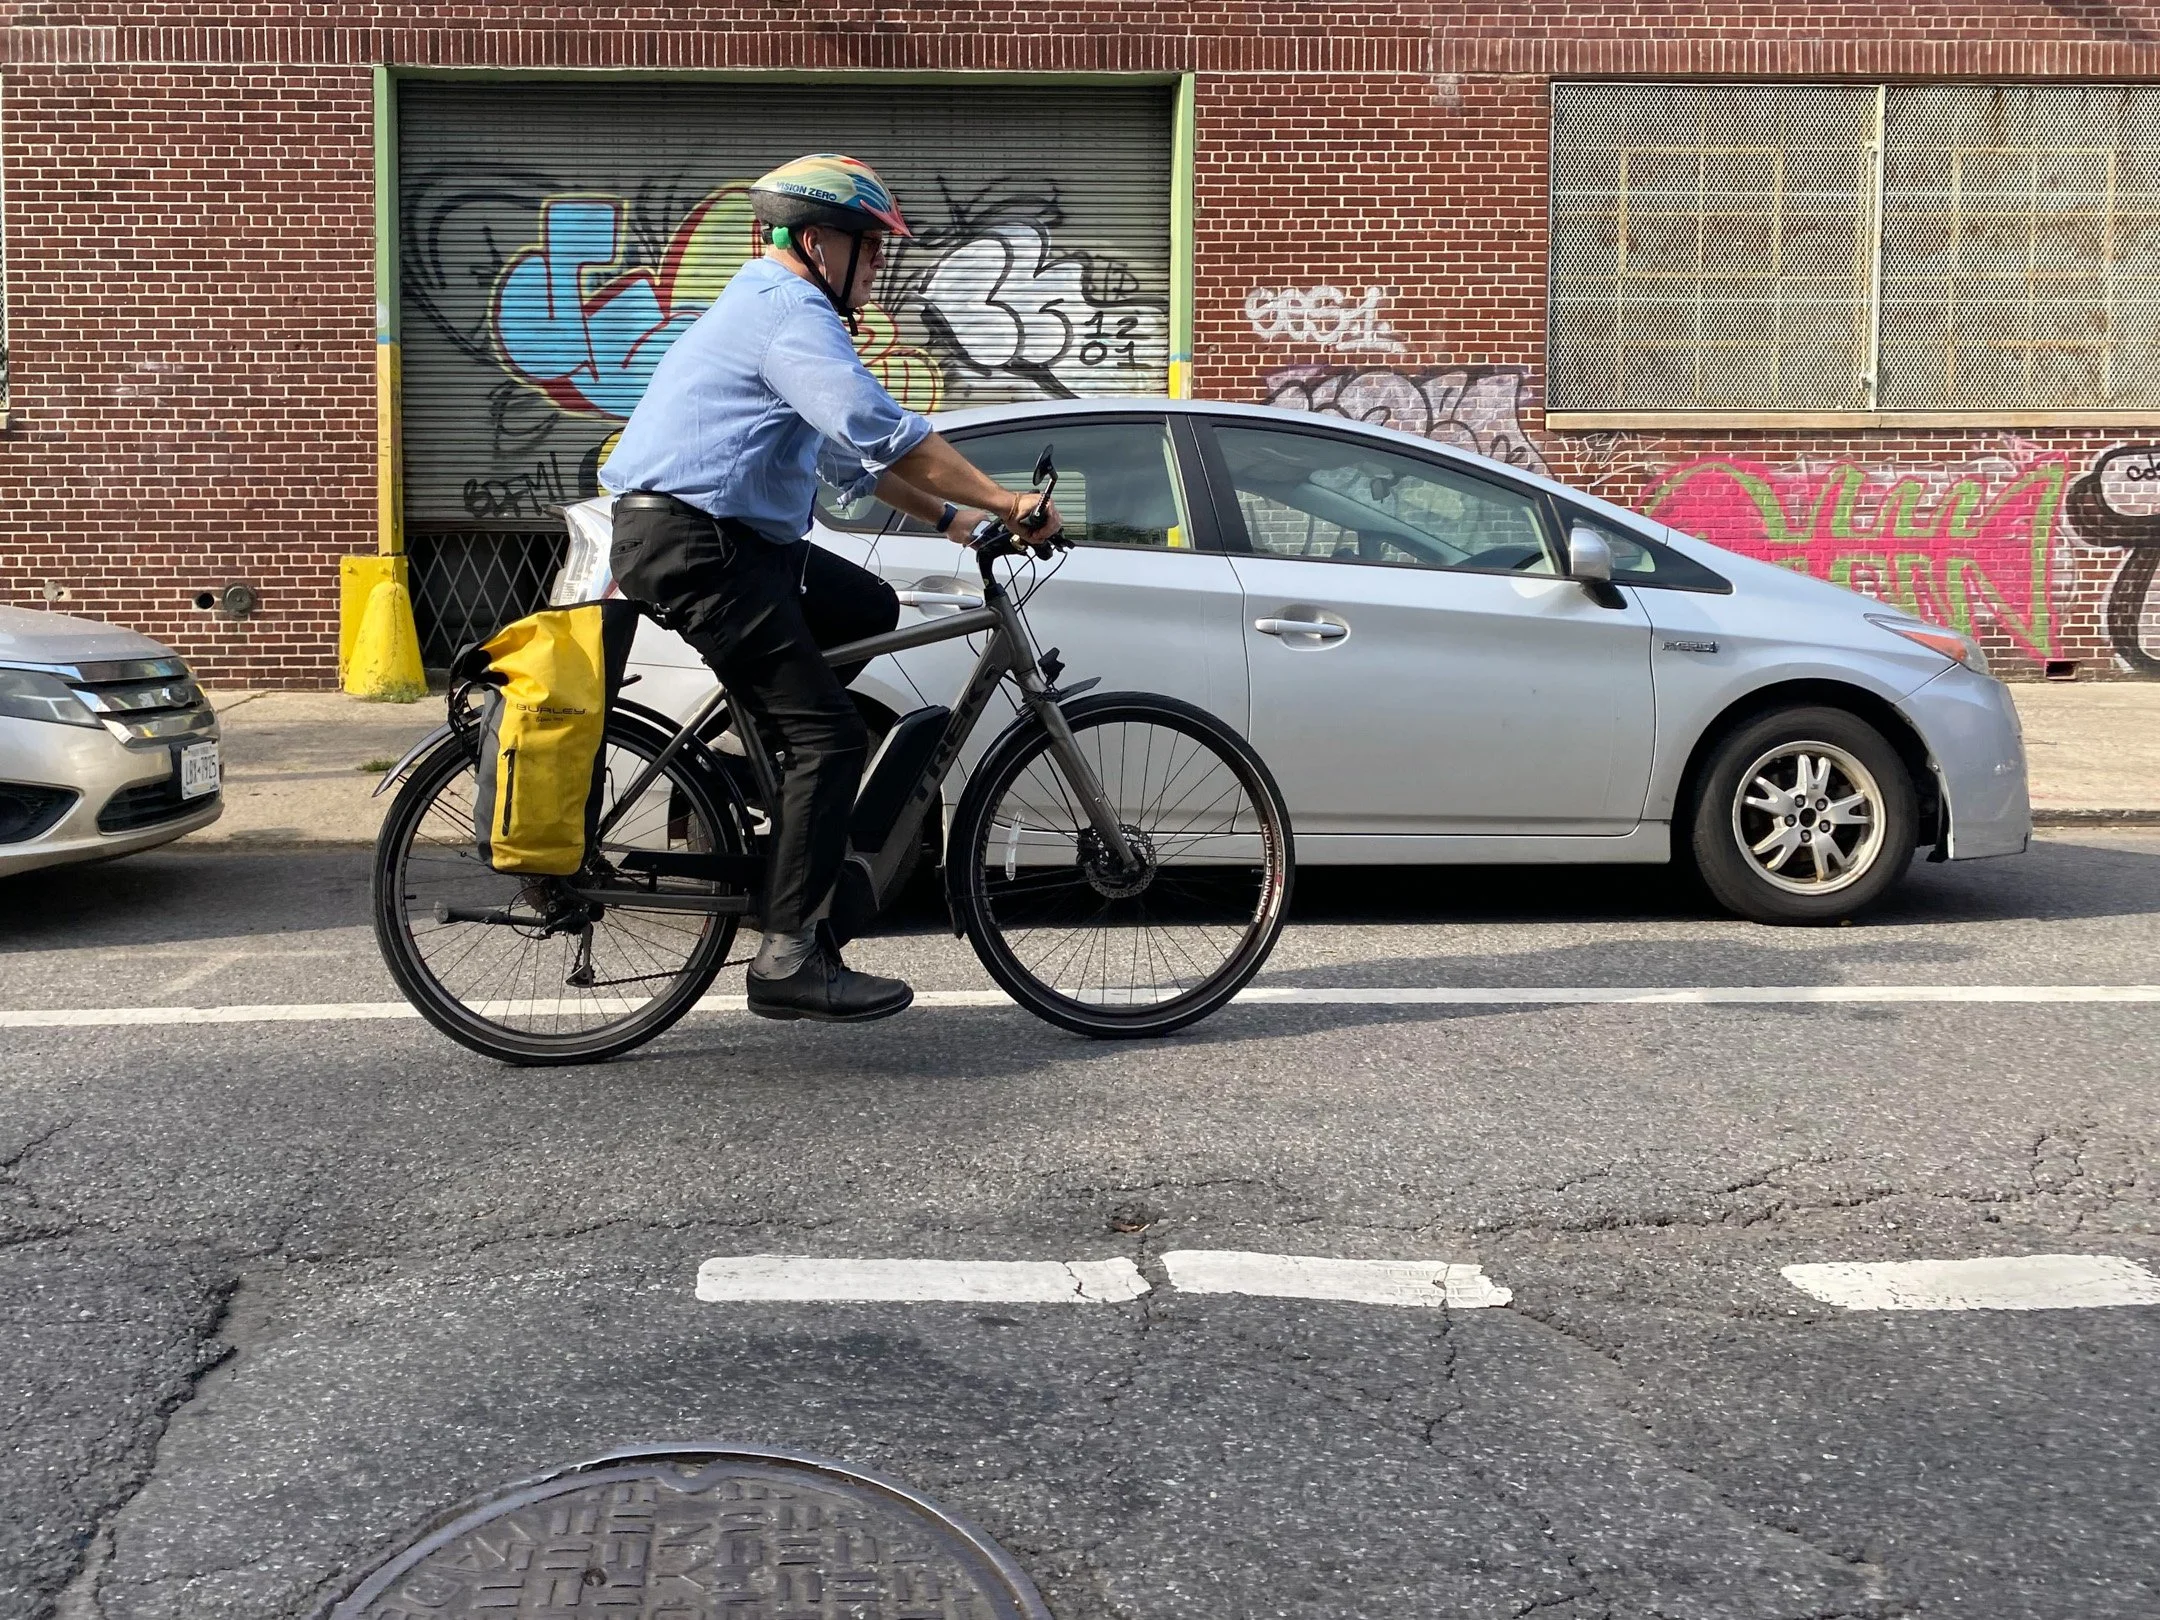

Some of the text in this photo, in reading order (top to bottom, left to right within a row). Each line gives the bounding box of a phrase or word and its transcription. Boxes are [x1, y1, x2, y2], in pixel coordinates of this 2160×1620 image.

[776, 181, 838, 201] VISION ZERO
[1083, 310, 1151, 339] 12
[1080, 340, 1152, 369] 01
[516, 703, 587, 715] BURLEY
[910, 684, 987, 803] TREK
[1257, 823, 1274, 916] CONNECTION
